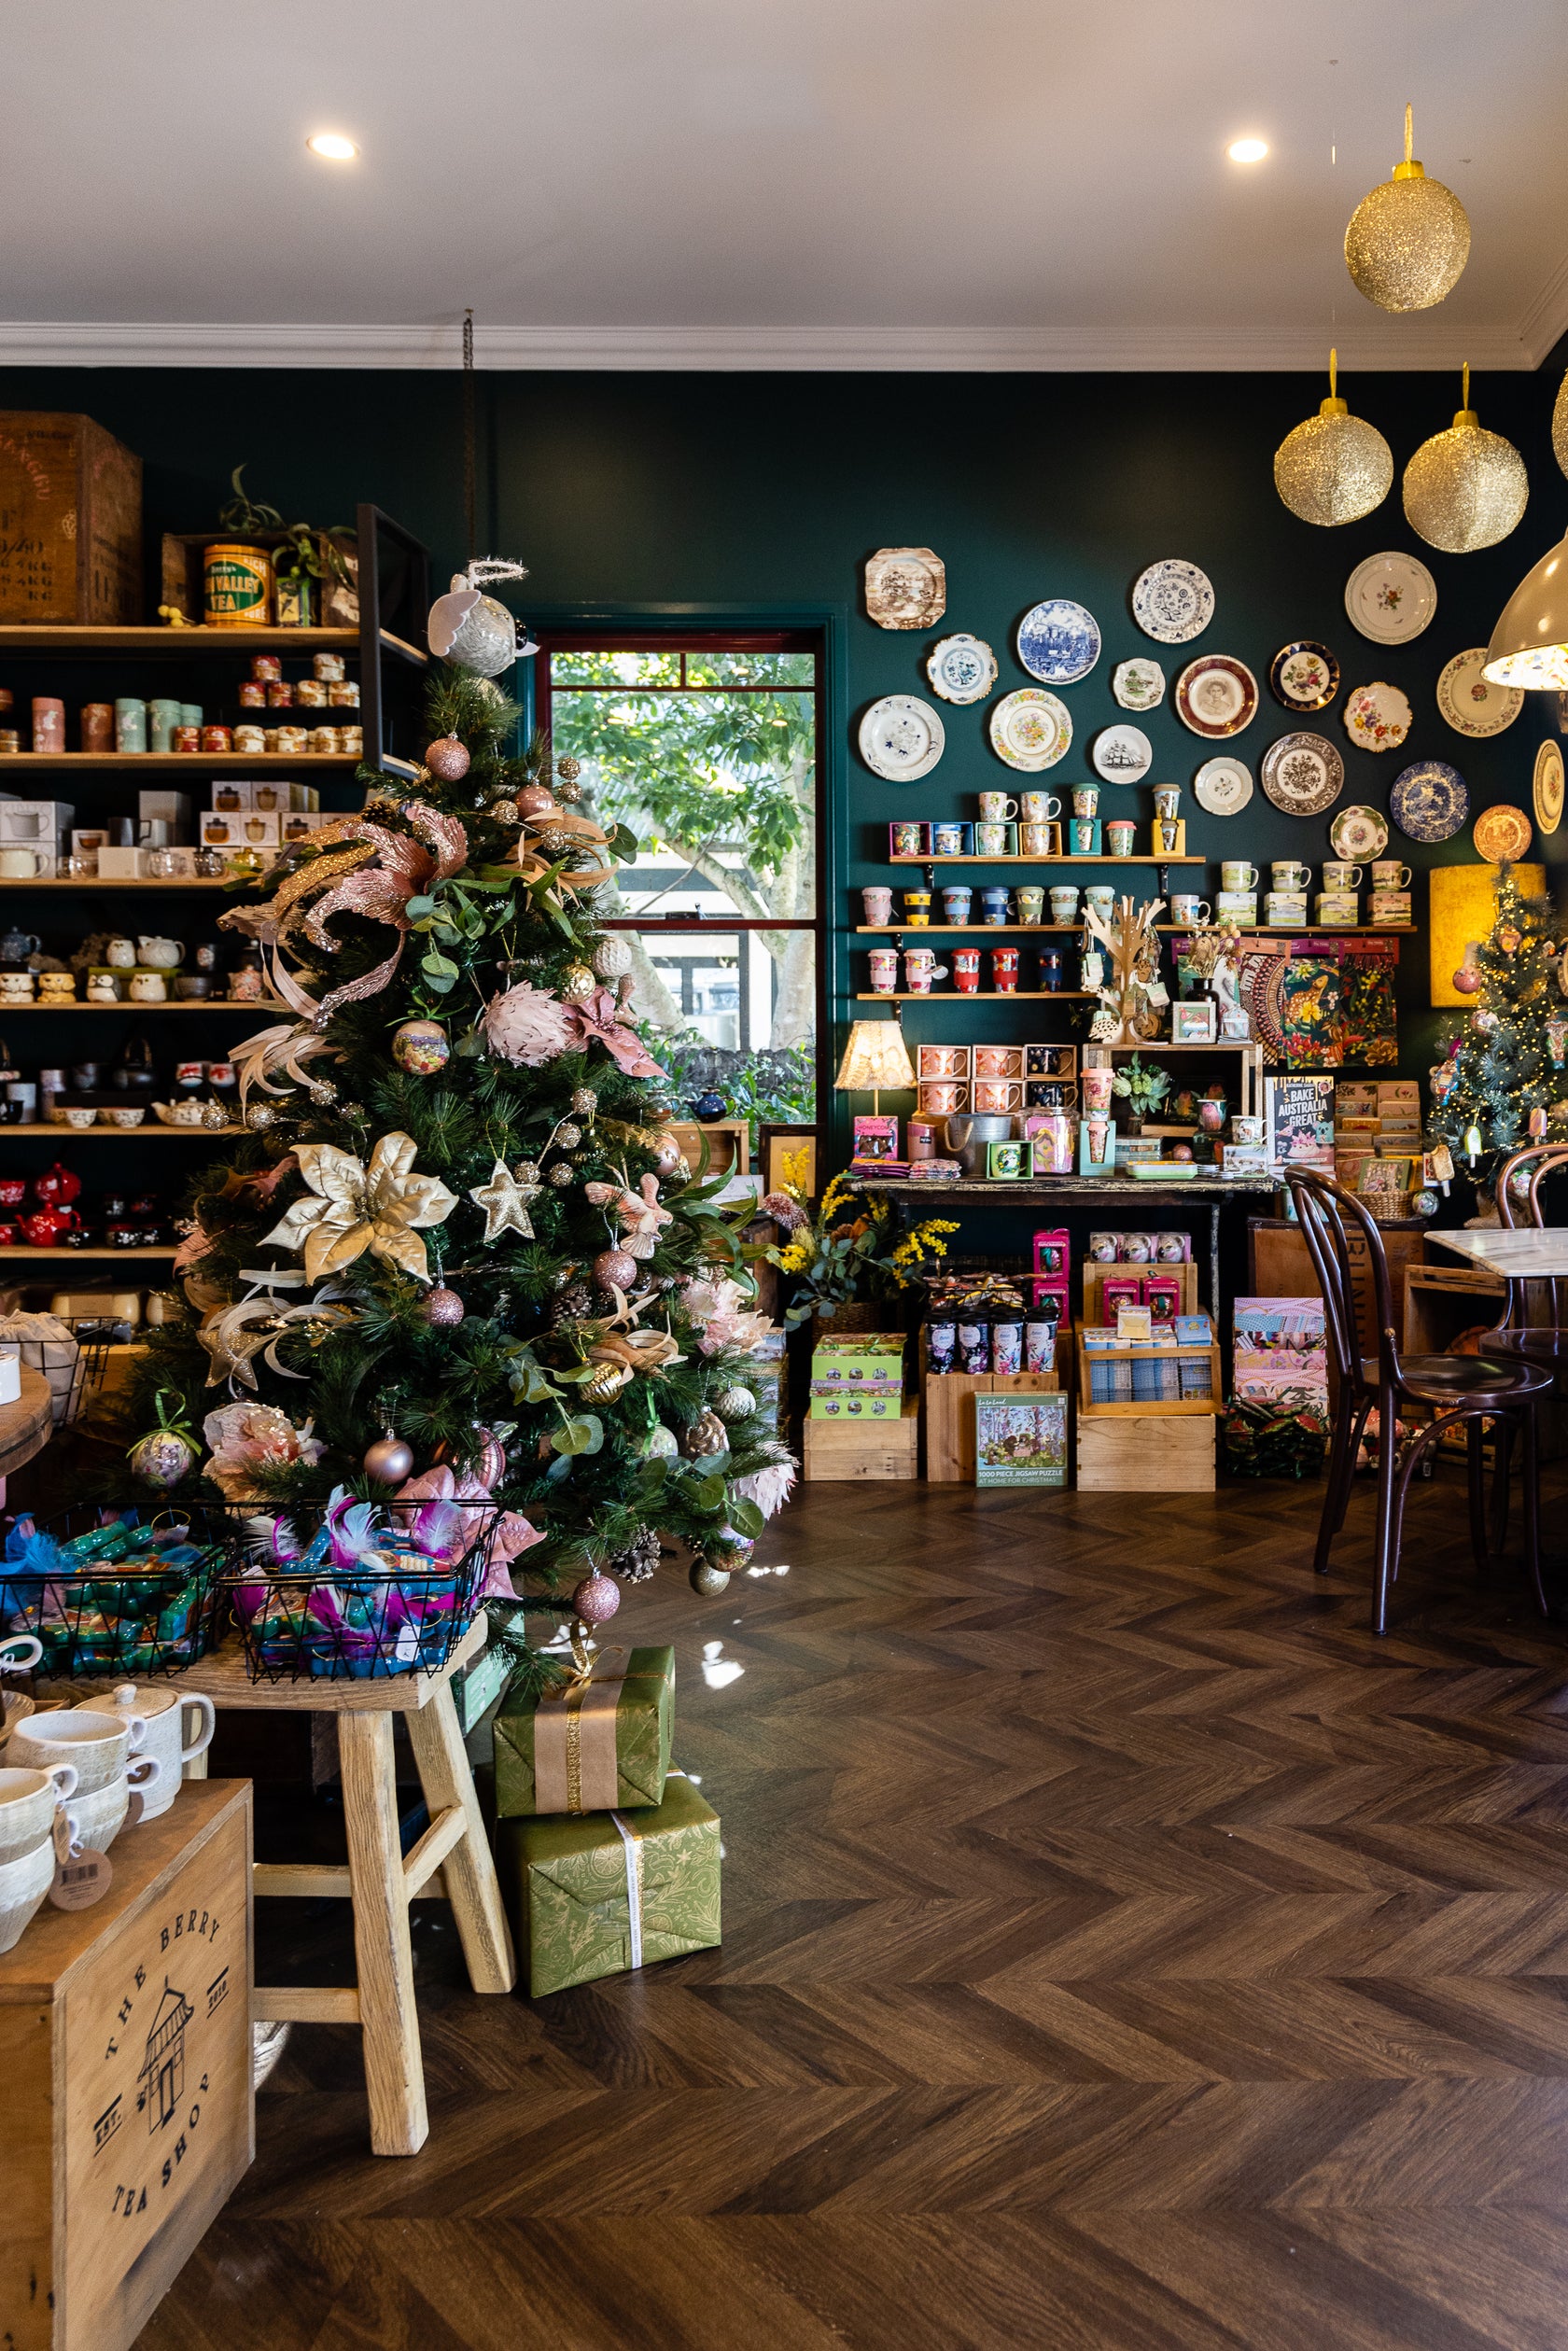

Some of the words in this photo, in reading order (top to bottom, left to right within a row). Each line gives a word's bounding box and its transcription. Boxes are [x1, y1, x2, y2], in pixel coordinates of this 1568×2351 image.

[216, 575, 259, 595] VALLEY
[210, 594, 236, 611] TEA
[1291, 1088, 1314, 1103] BAKE
[1278, 1099, 1327, 1117] AUSTRALIA
[1289, 1113, 1318, 1127] GREAT
[105, 1963, 147, 2061] THE
[160, 1910, 220, 1953] BERRY
[208, 1980, 227, 2009] 2010
[96, 2108, 121, 2148] EST.
[112, 2184, 147, 2217] TEA
[161, 2072, 210, 2189] SHOP
